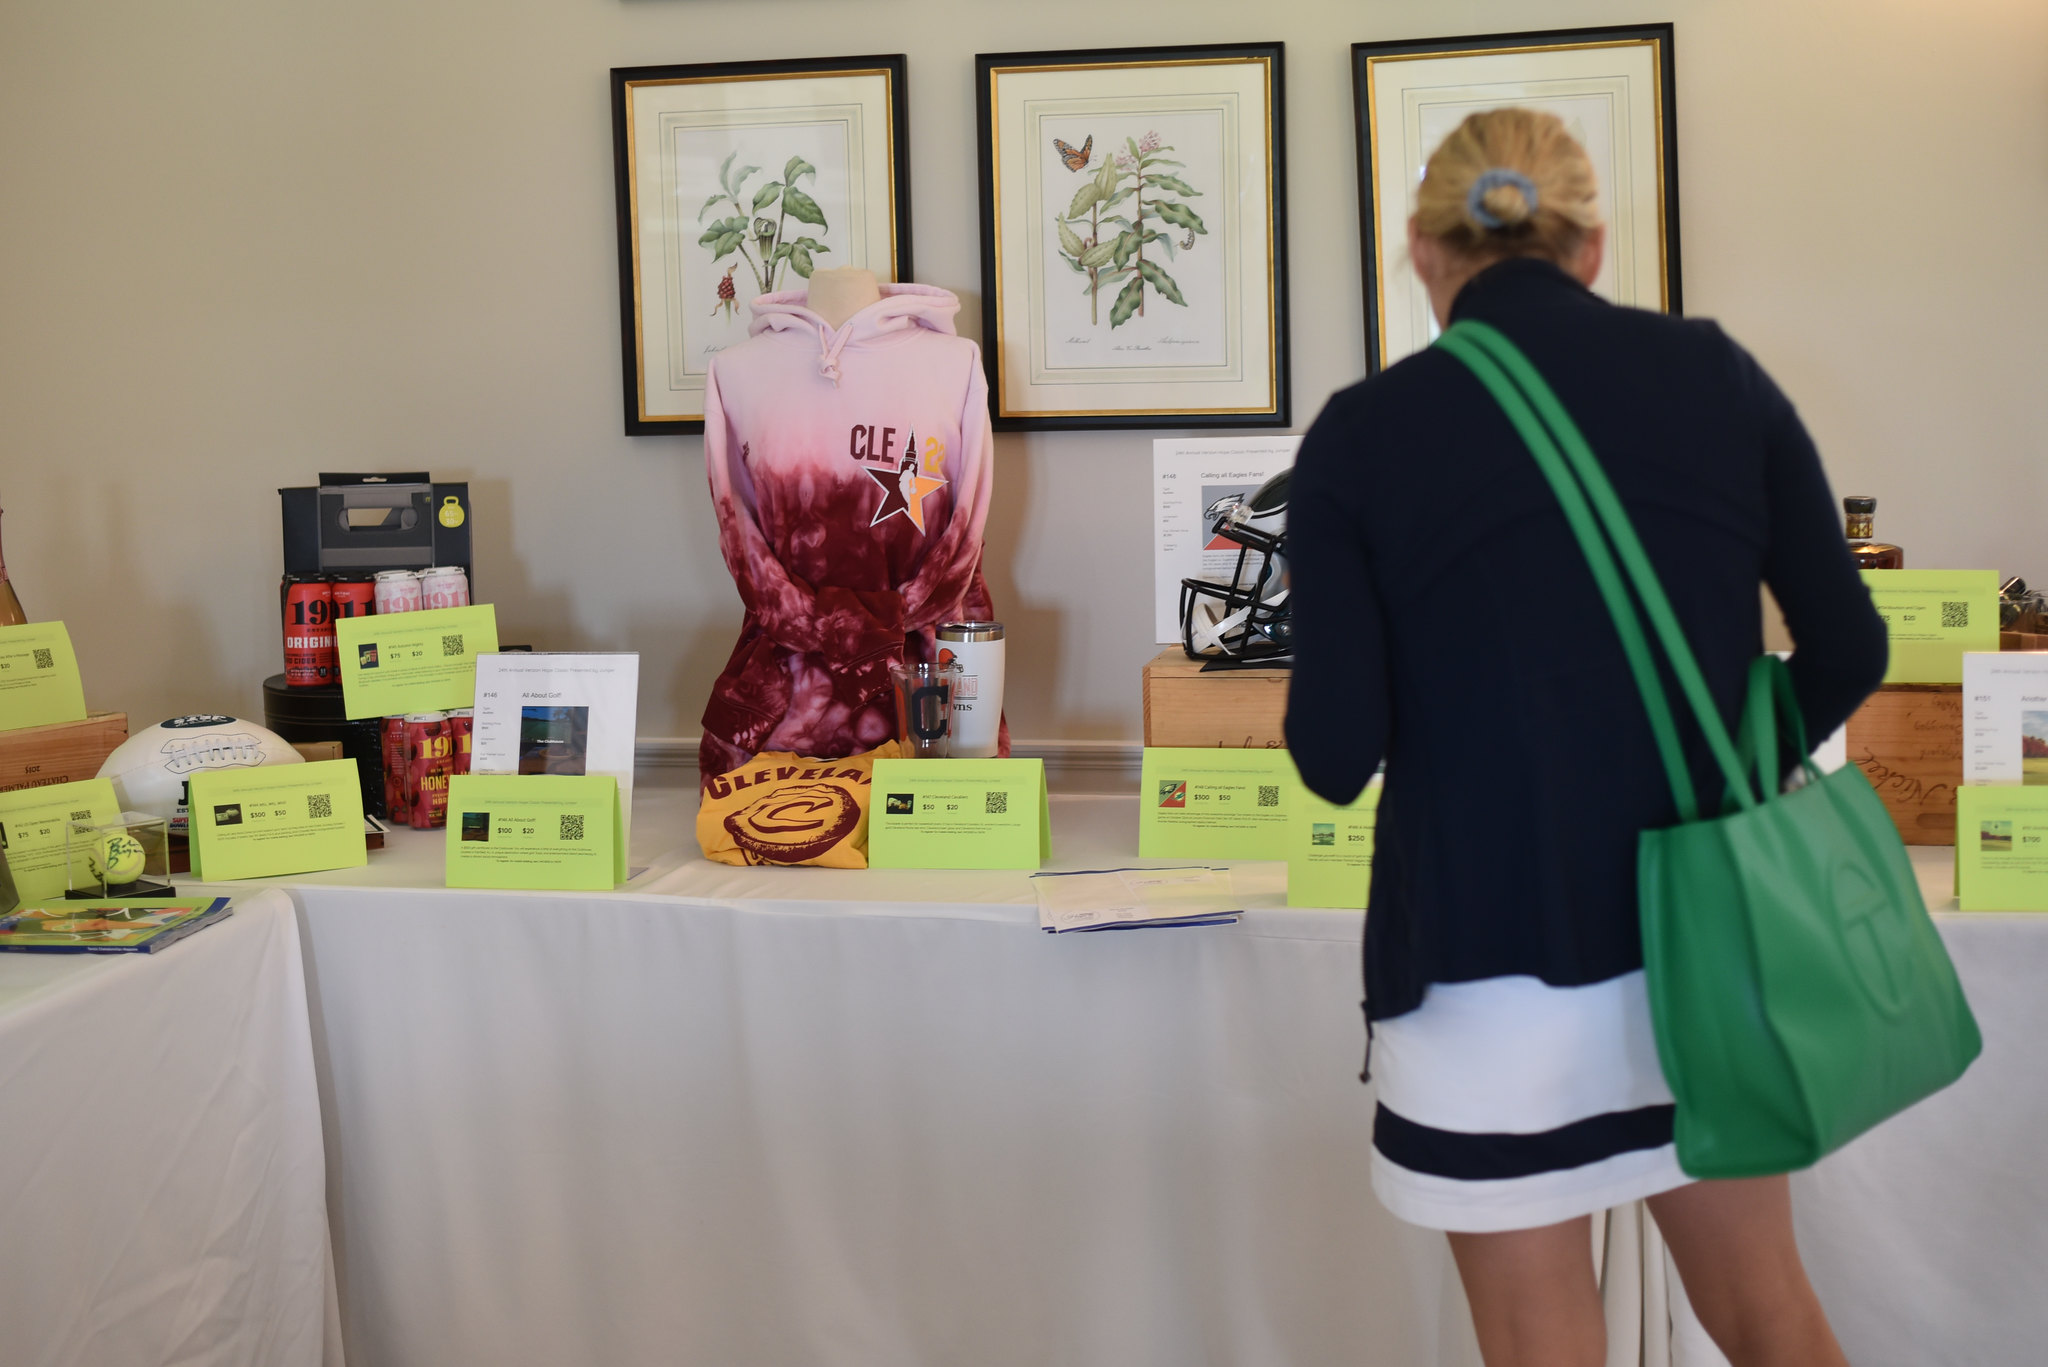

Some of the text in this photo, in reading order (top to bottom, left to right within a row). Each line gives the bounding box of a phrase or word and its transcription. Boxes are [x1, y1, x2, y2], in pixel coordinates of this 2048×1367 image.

[850, 424, 896, 463] CLE
[1229, 471, 1248, 479] Eagles
[287, 636, 333, 649] ORIGIN
[275, 809, 287, 817] $50
[1347, 834, 1365, 842] $250
